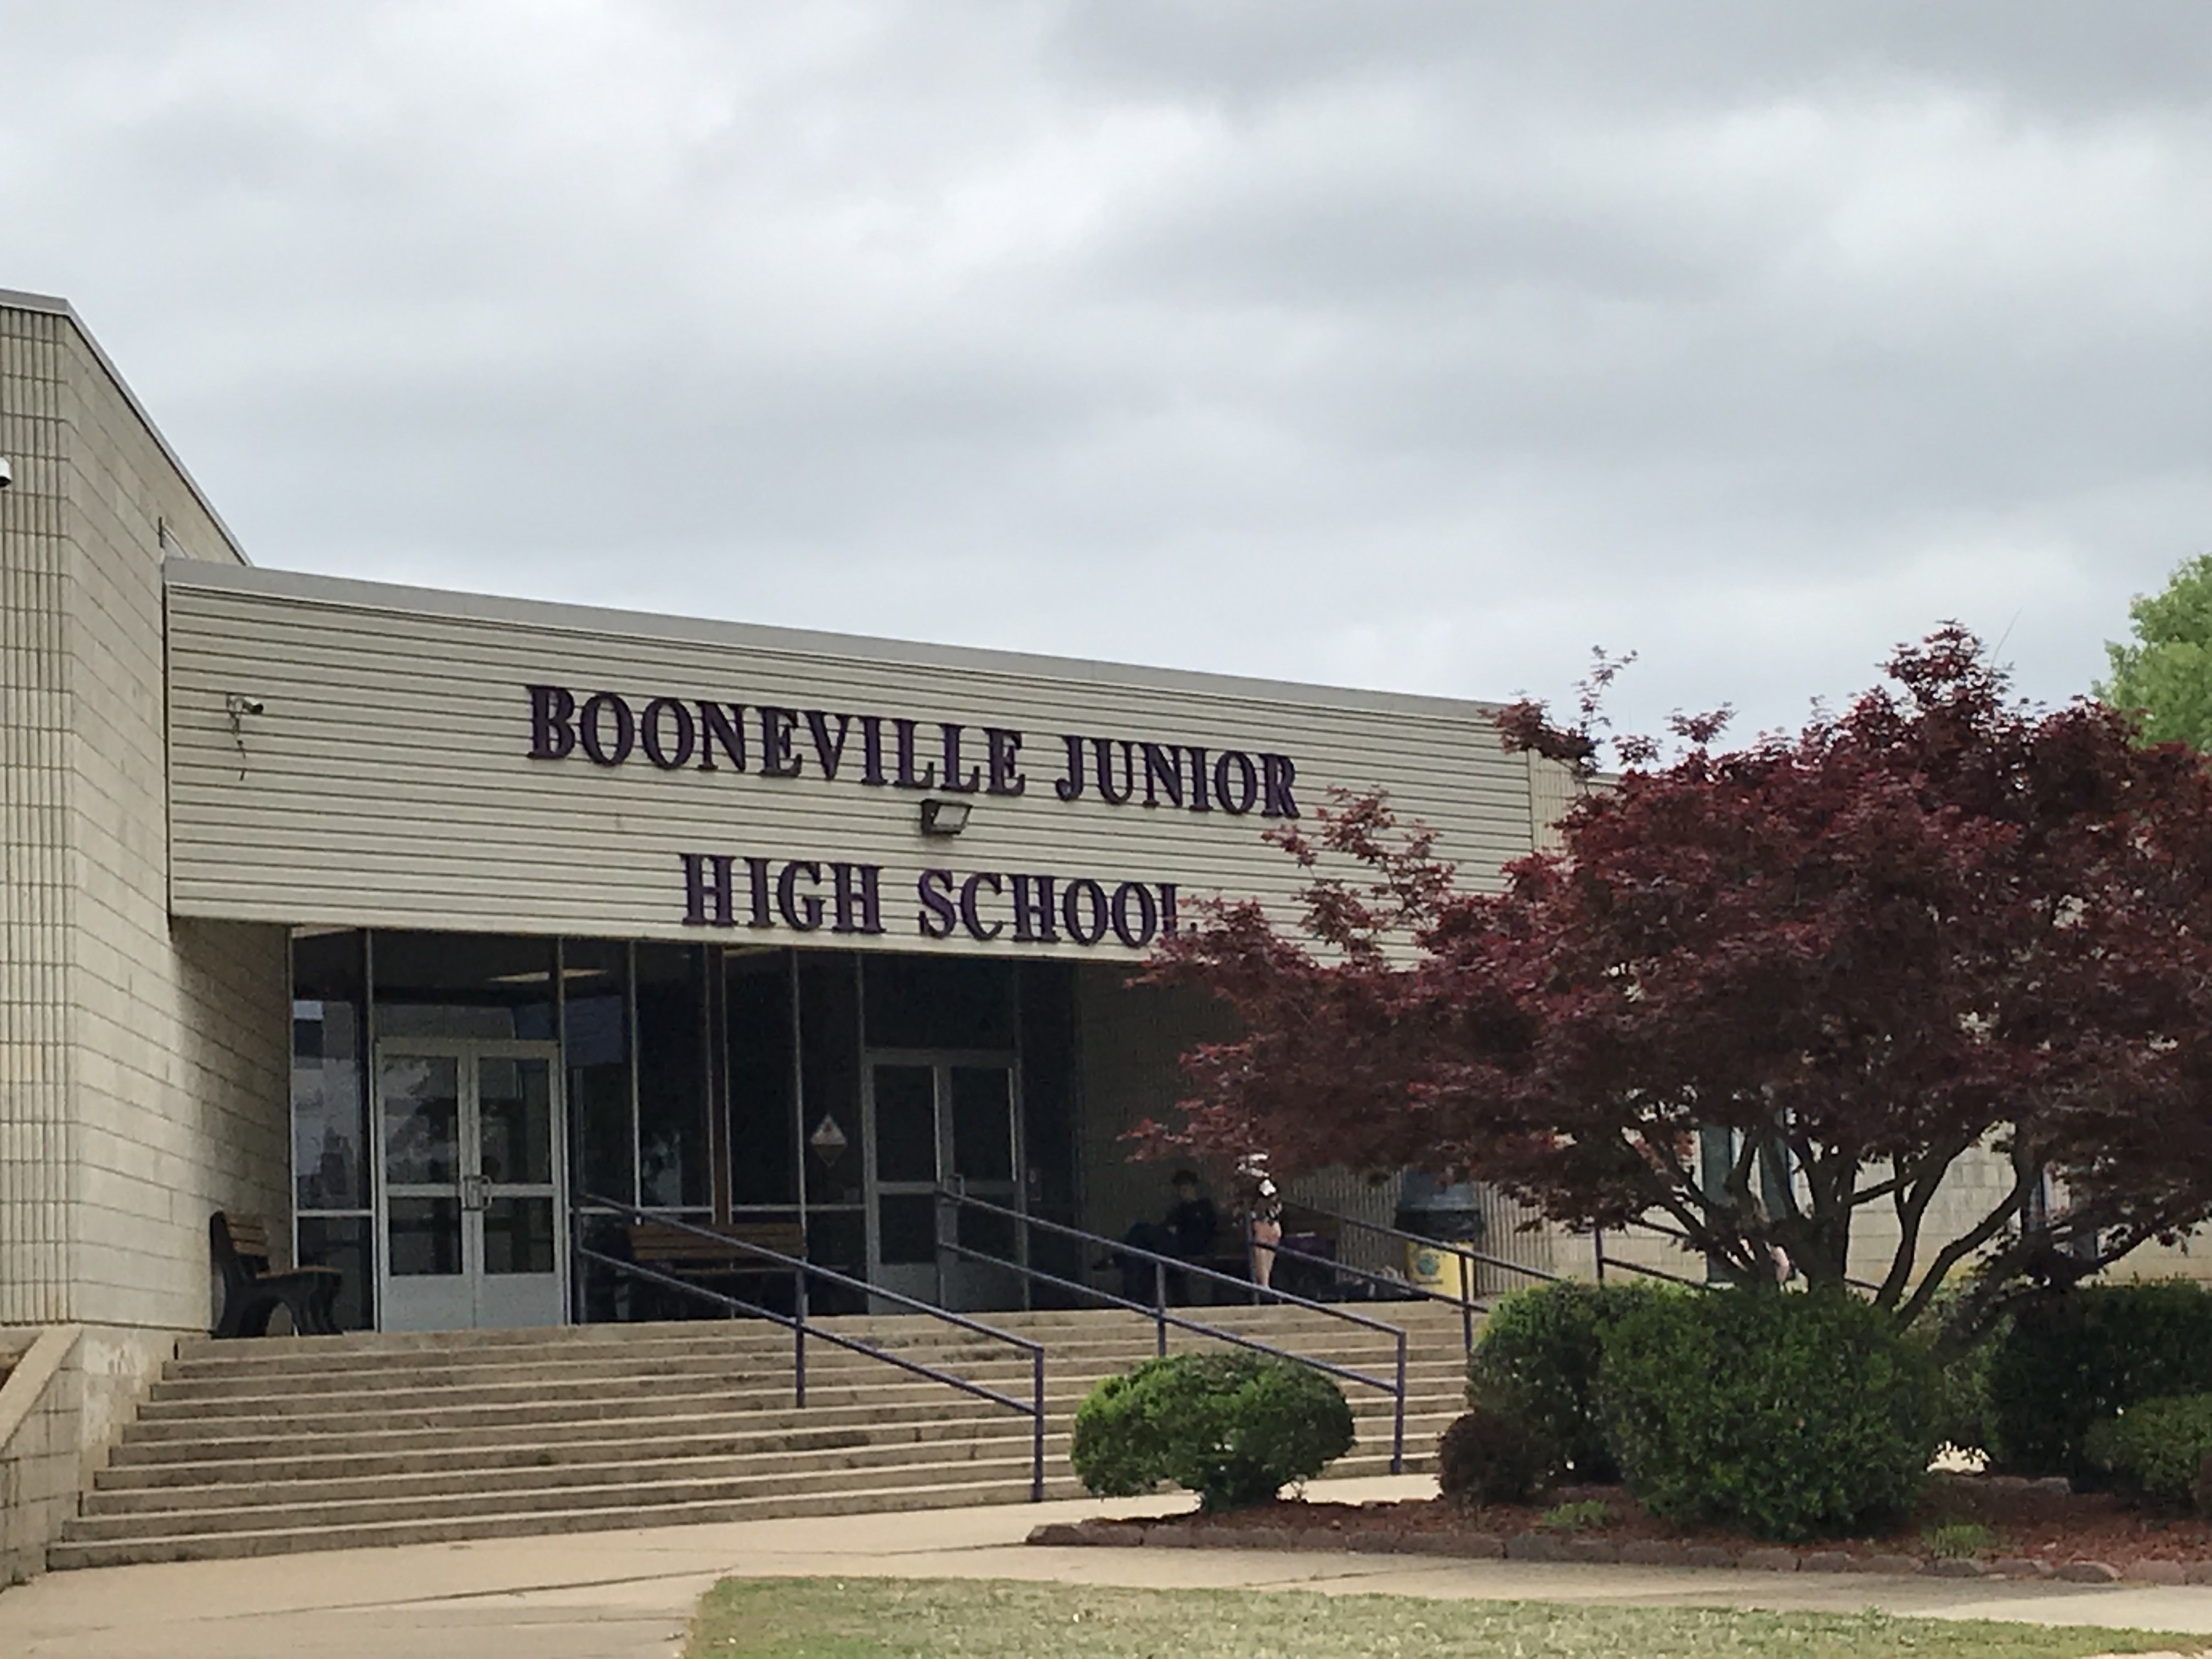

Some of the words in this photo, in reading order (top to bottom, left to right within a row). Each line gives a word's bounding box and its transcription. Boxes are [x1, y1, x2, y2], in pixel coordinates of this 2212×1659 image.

[526, 685, 1025, 797] BOONEVILLE
[1056, 736, 1300, 819] JUNIOR
[680, 853, 885, 934] HIGH
